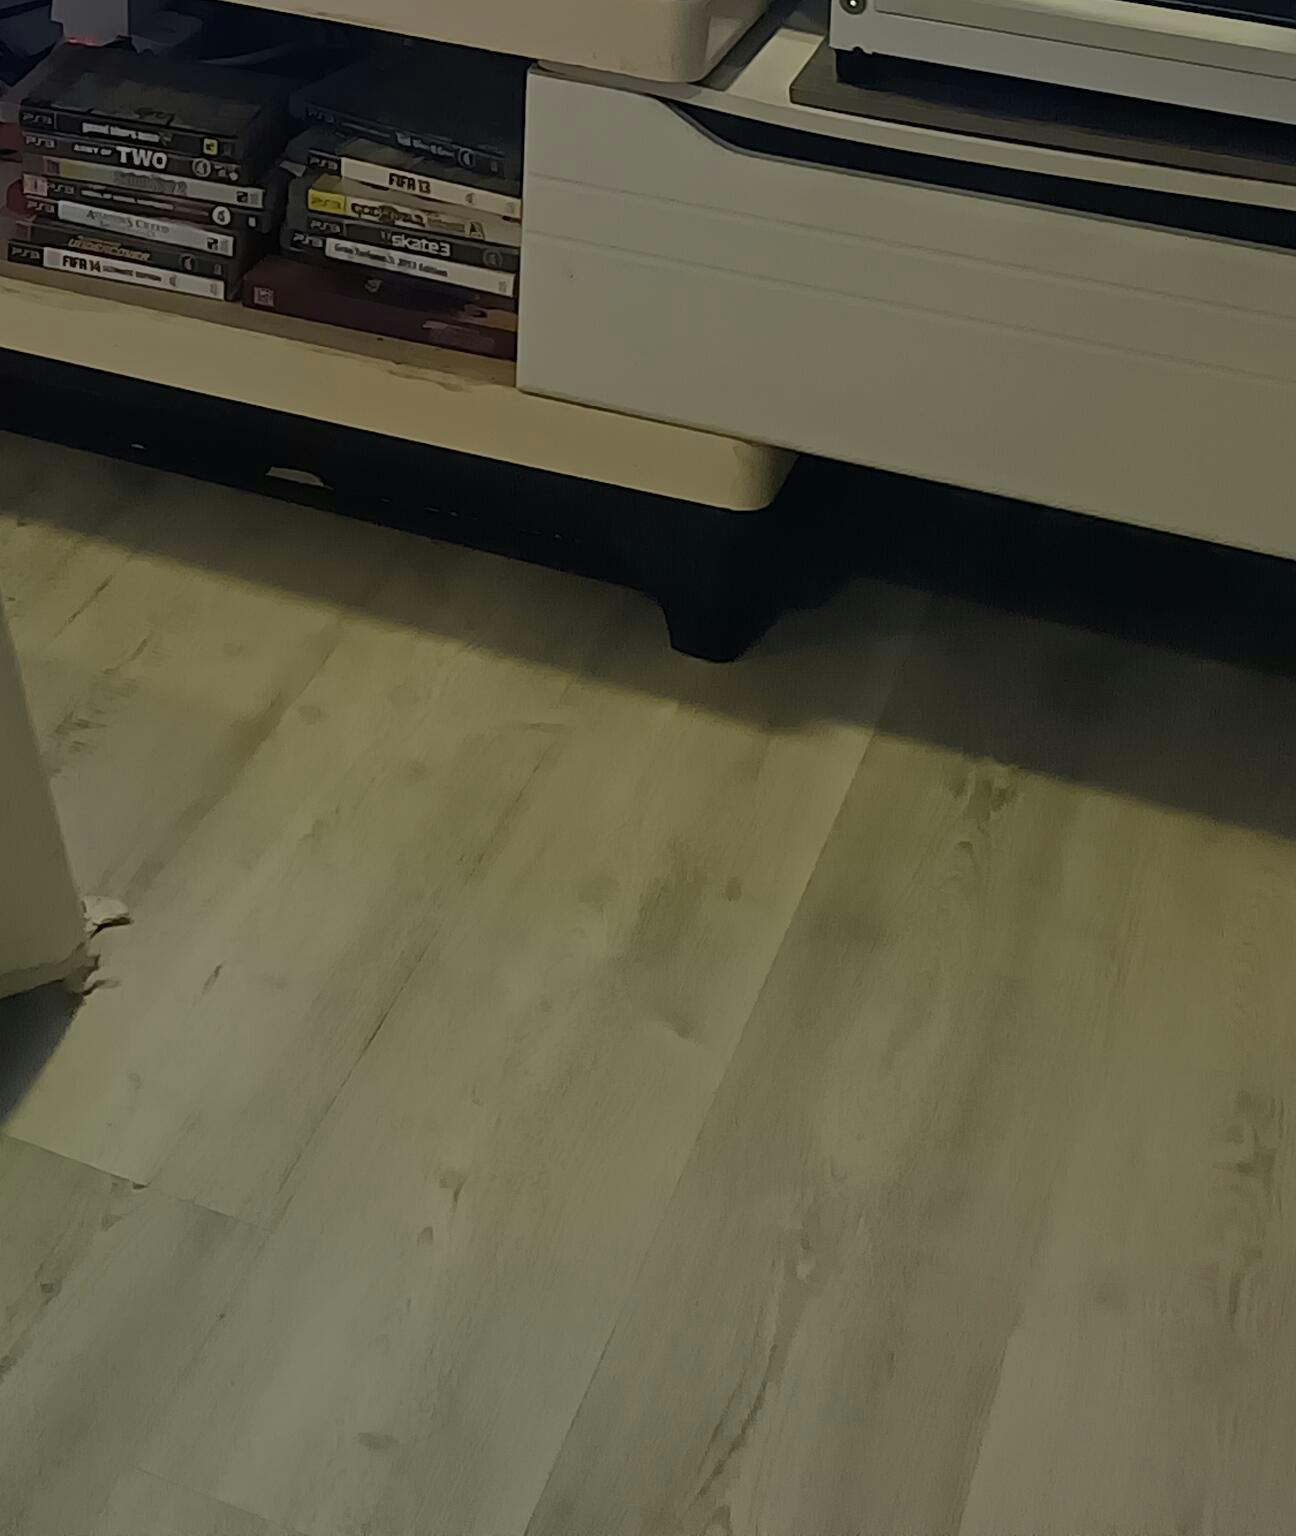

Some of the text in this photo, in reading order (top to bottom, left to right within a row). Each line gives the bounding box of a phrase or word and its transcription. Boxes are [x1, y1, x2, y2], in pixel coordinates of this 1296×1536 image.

[24, 135, 56, 149] PS3
[115, 145, 169, 170] TWO
[308, 157, 431, 194] PS3 FIFA 13
[293, 231, 324, 247] PS3
[310, 220, 341, 233] PS3
[10, 246, 41, 260] PS3
[62, 255, 87, 270] FIFA
[88, 258, 102, 273] 14
